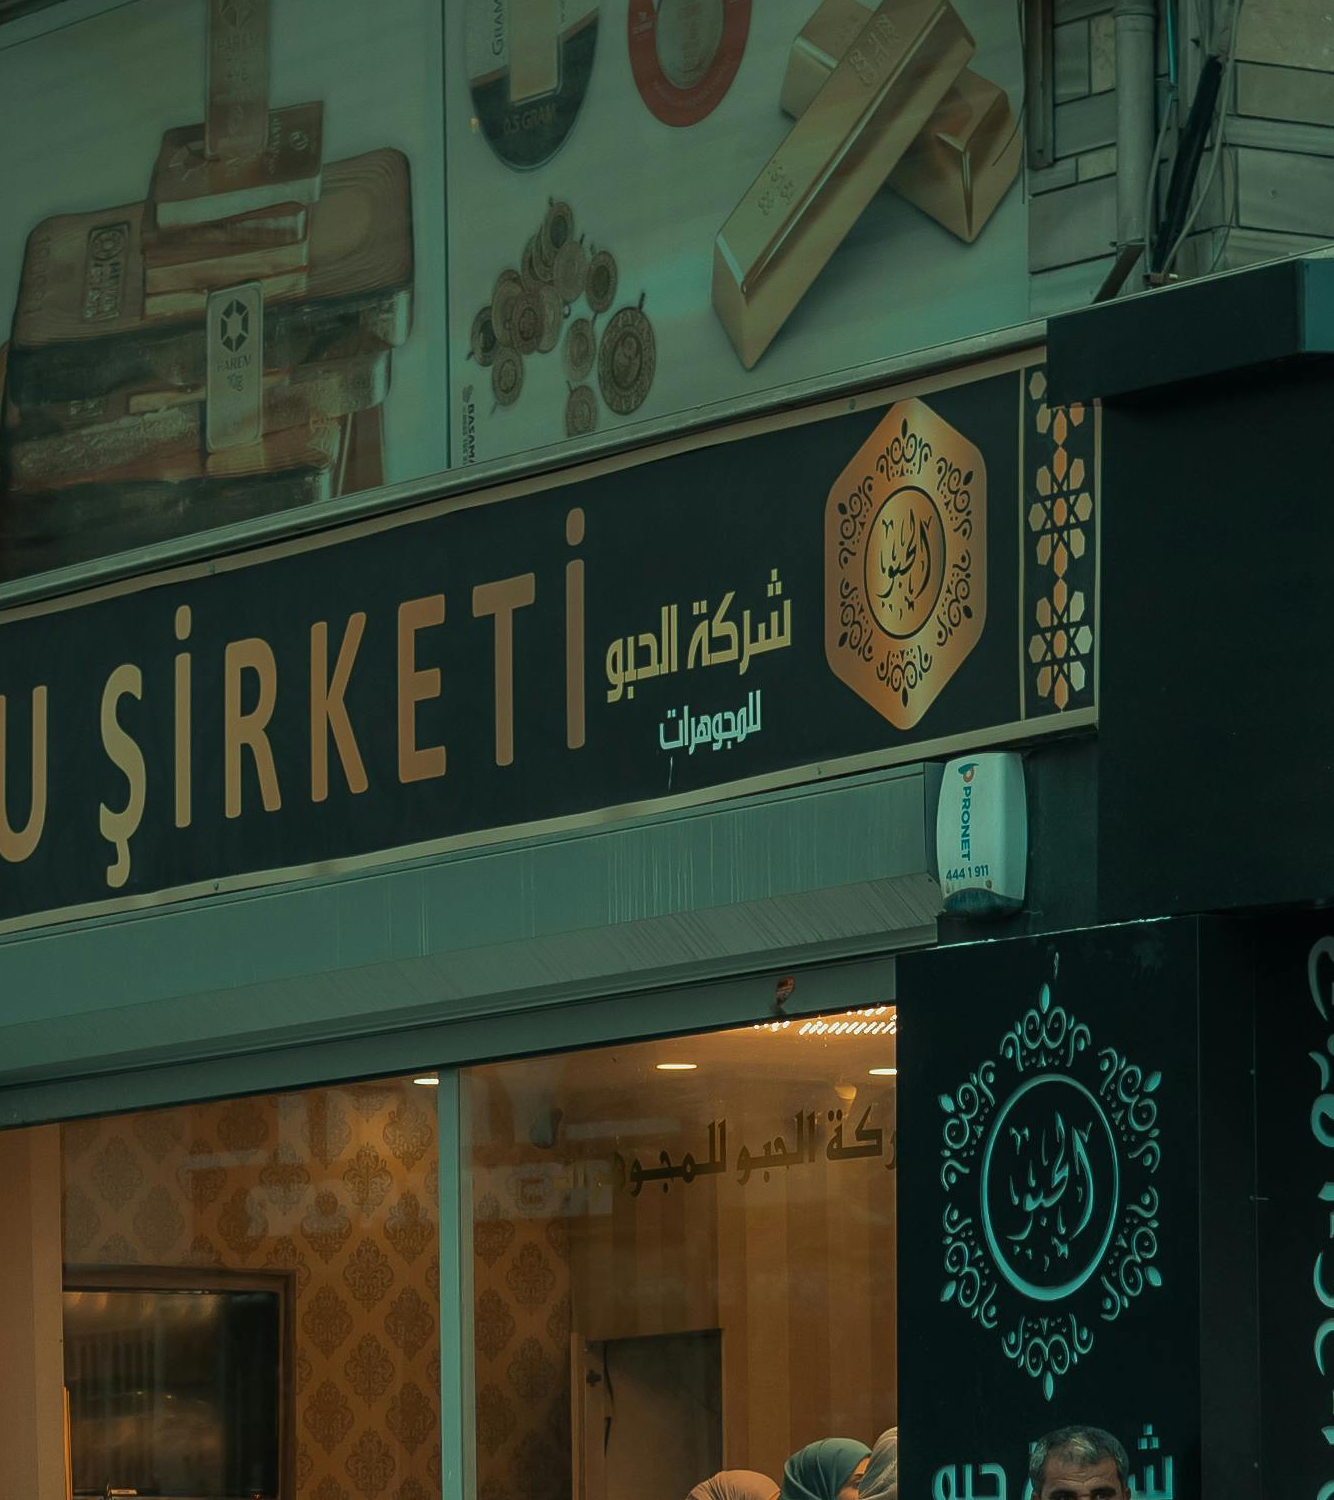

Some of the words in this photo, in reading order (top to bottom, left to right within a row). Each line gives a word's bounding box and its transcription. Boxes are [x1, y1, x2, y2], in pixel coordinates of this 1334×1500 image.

[605, 603, 678, 703] الحبو
[686, 568, 791, 676] شركة
[99, 506, 585, 889] ŞİRKETİ
[659, 689, 762, 755] للمجوهرات
[961, 786, 972, 861] PRONET
[946, 867, 966, 880] 444
[975, 865, 989, 878] 911
[827, 1106, 895, 1171] ركة
